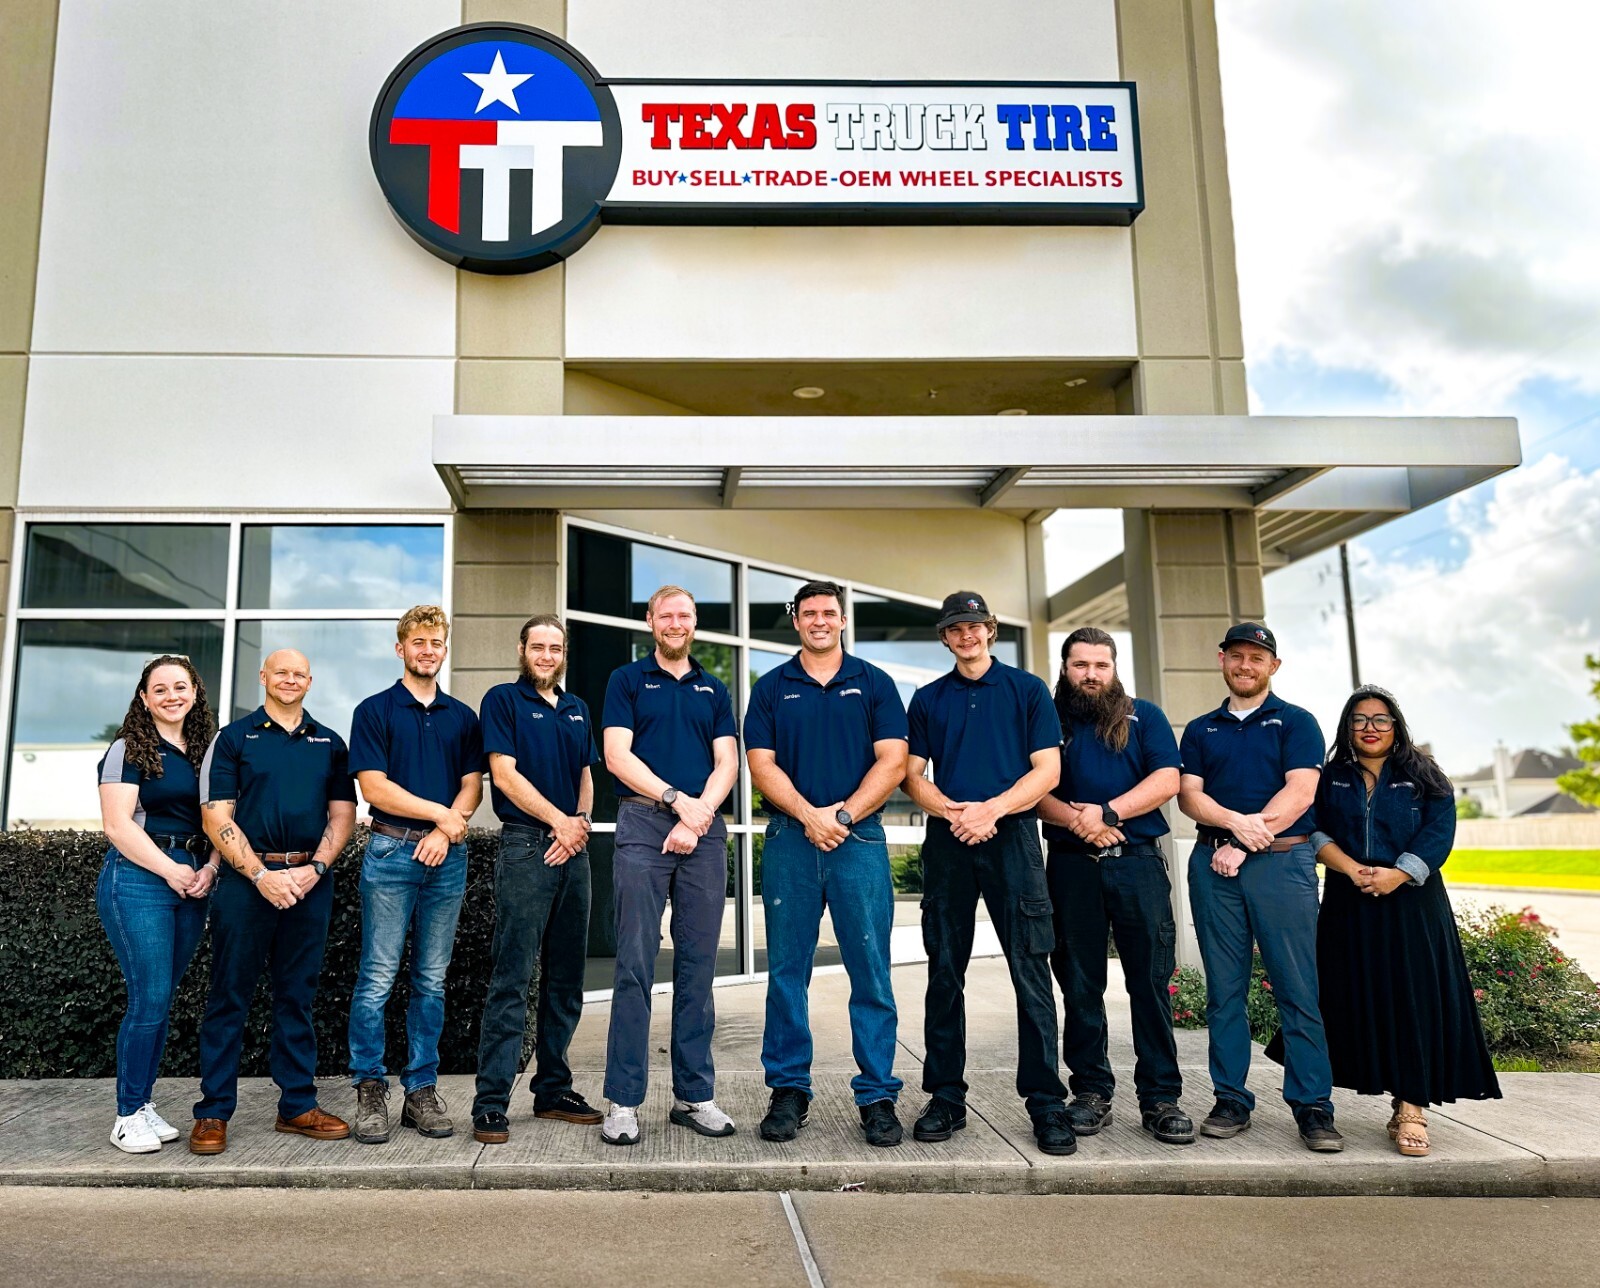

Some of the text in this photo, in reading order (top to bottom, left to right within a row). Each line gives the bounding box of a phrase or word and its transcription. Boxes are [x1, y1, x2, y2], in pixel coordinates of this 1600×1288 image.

[642, 103, 1118, 151] TEXAS TRUCK TIRE
[900, 171, 979, 187] WHEEL
[985, 170, 1123, 188] SPECIALISTS
